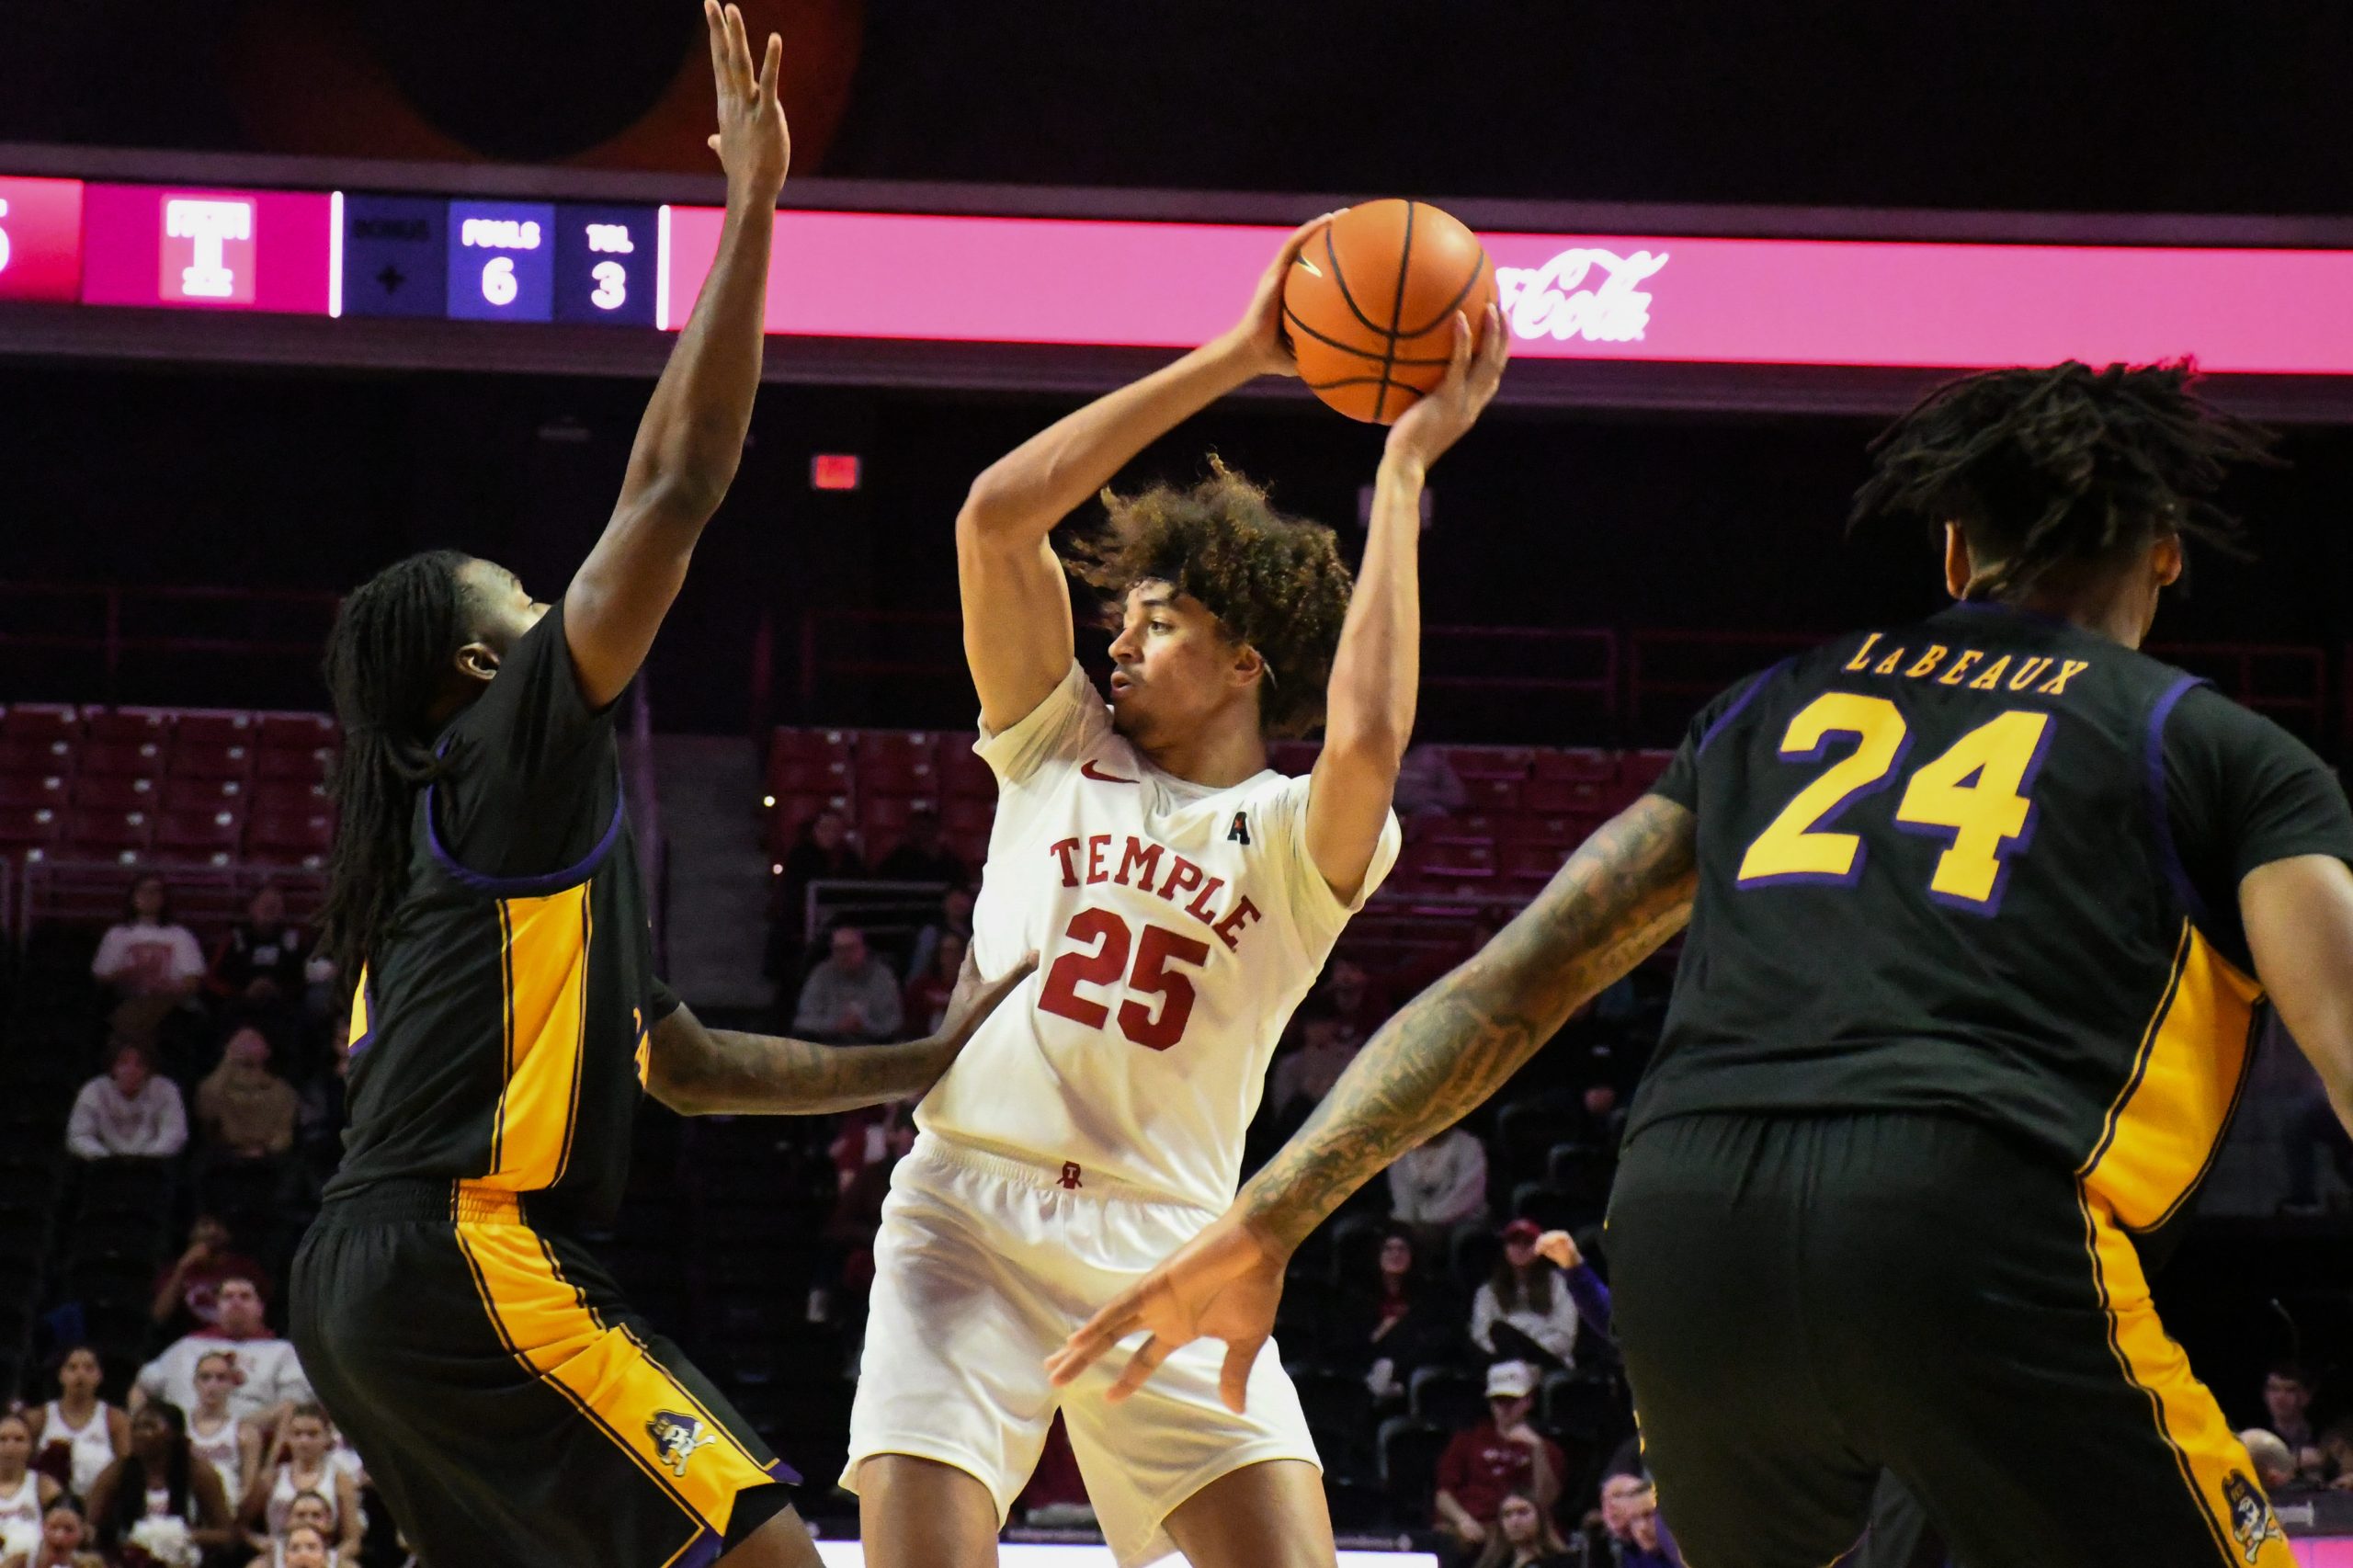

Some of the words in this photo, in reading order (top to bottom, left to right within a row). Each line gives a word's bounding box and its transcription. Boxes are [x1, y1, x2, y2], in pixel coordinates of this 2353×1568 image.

[461, 219, 541, 250] FOULS
[482, 256, 517, 305] 6
[591, 261, 626, 310] 3
[1844, 631, 2089, 696] LABEAUX
[1736, 691, 2055, 916] 24
[1050, 834, 1262, 954] TEMPLE
[1037, 906, 1211, 1052] 25
